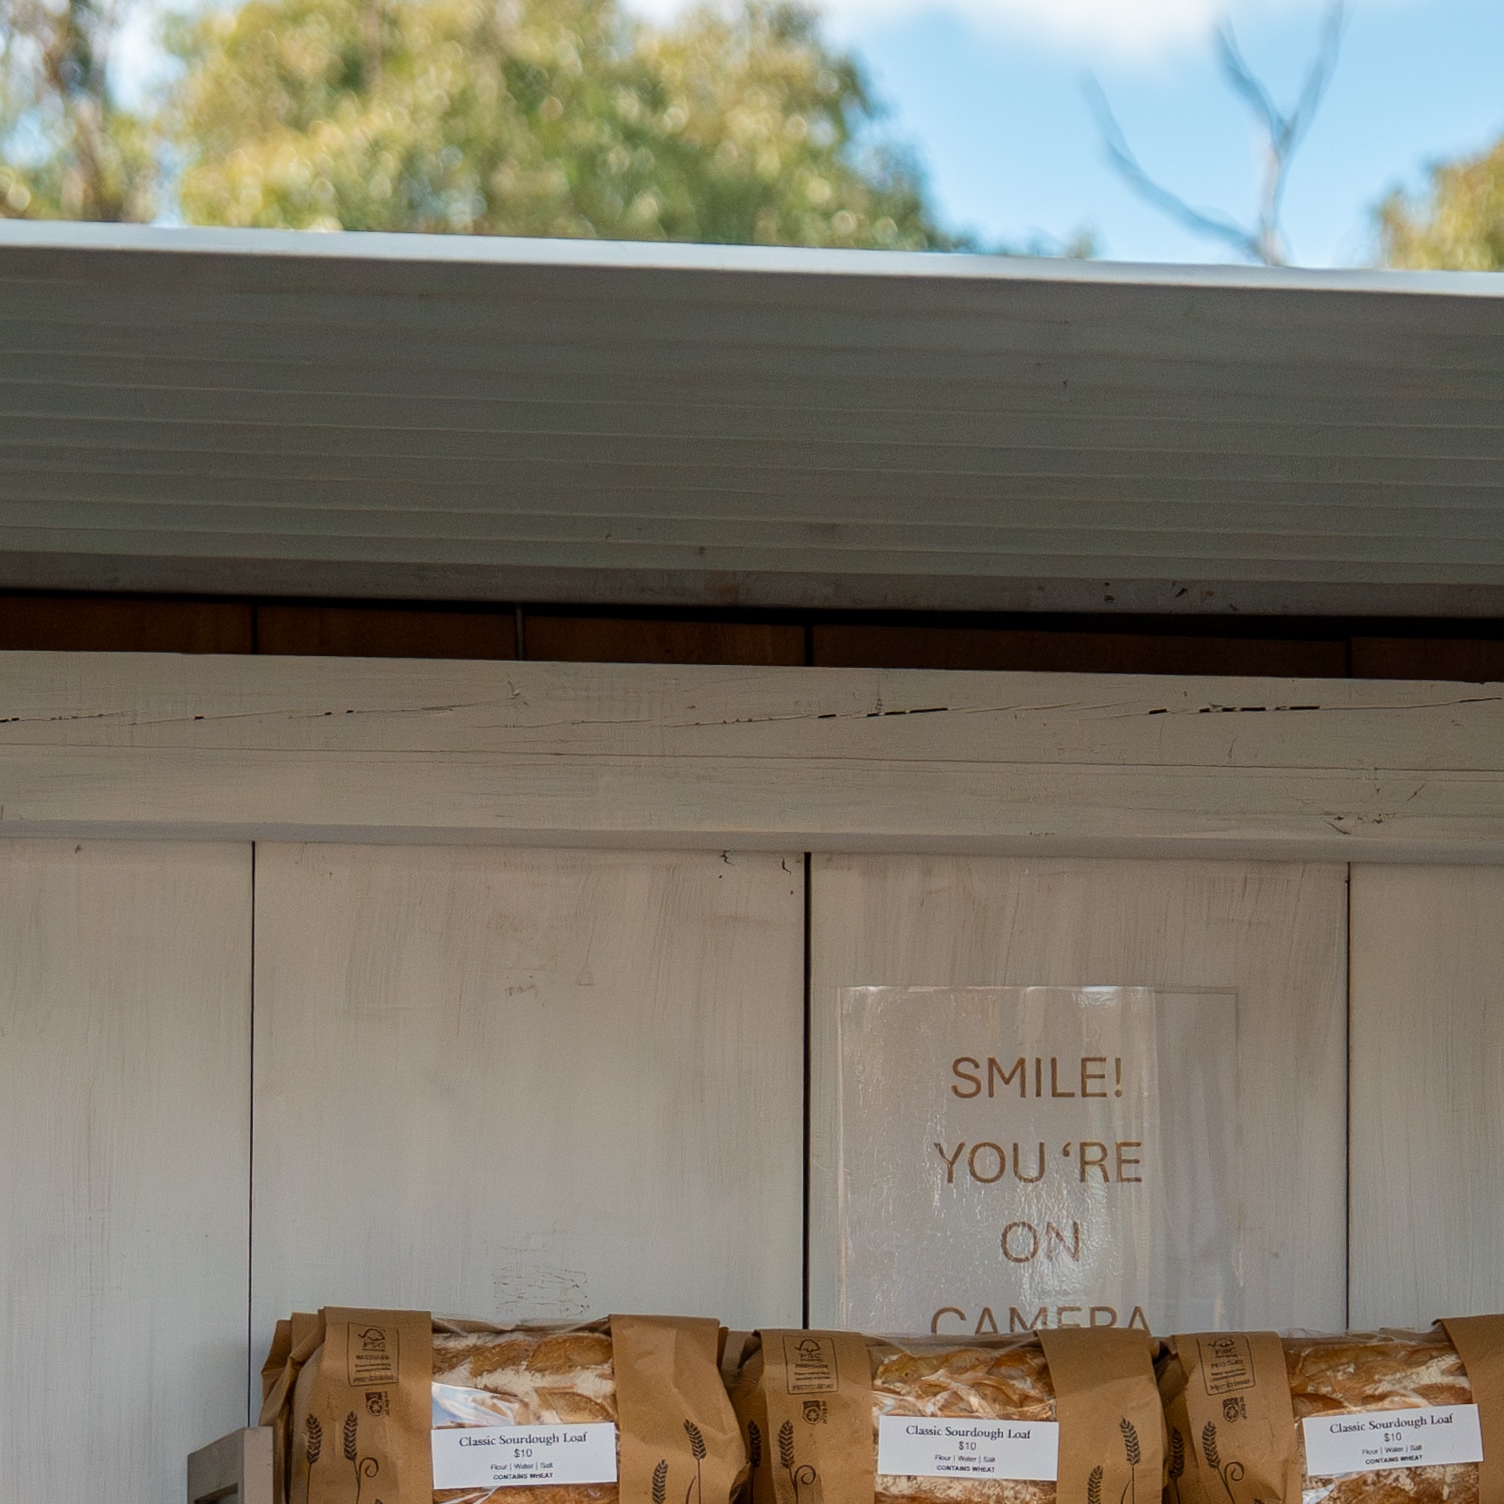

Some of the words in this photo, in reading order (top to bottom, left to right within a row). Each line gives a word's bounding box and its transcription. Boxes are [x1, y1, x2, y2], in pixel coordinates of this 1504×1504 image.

[951, 1056, 1123, 1099] SMILE!
[1001, 1221, 1080, 1264] ON
[1330, 1421, 1366, 1434] Classic
[1369, 1414, 1427, 1430] Sourdough
[1431, 1413, 1453, 1424] Loaf
[459, 1435, 496, 1447] Classic
[499, 1433, 559, 1447] Sourdough
[564, 1432, 588, 1443] Loaf
[906, 1425, 942, 1436] Classic
[945, 1426, 1004, 1440] Sourdough
[1008, 1429, 1031, 1439] Loaf
[1384, 1432, 1402, 1442] $10
[514, 1448, 533, 1458] $10
[958, 1441, 976, 1451] $10
[1365, 1456, 1398, 1465] CONTAINS
[1401, 1454, 1423, 1462] WHEAT
